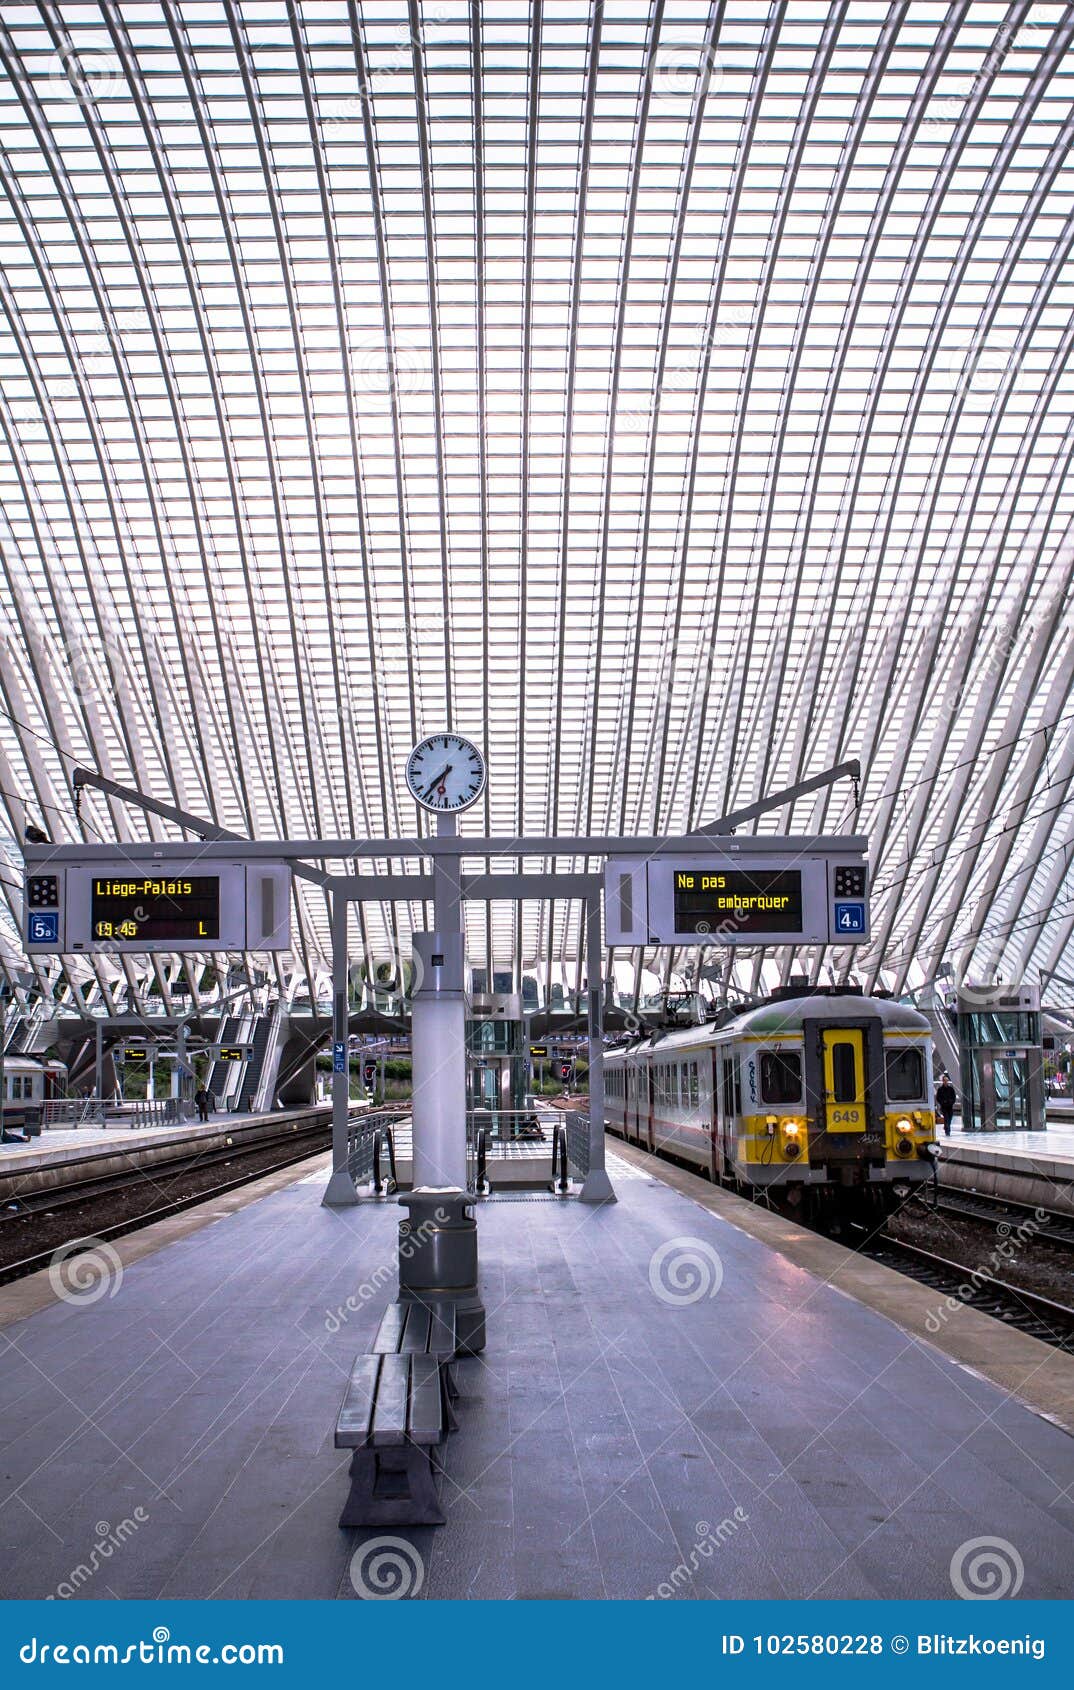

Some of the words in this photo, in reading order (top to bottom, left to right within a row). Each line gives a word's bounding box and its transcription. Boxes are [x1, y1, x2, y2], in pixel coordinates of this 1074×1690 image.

[678, 874, 694, 889] Ne
[701, 876, 726, 891] pas
[717, 894, 789, 911] embarquer
[97, 922, 137, 937] 19:45
[199, 921, 208, 936] L
[832, 1110, 860, 1124] 649
